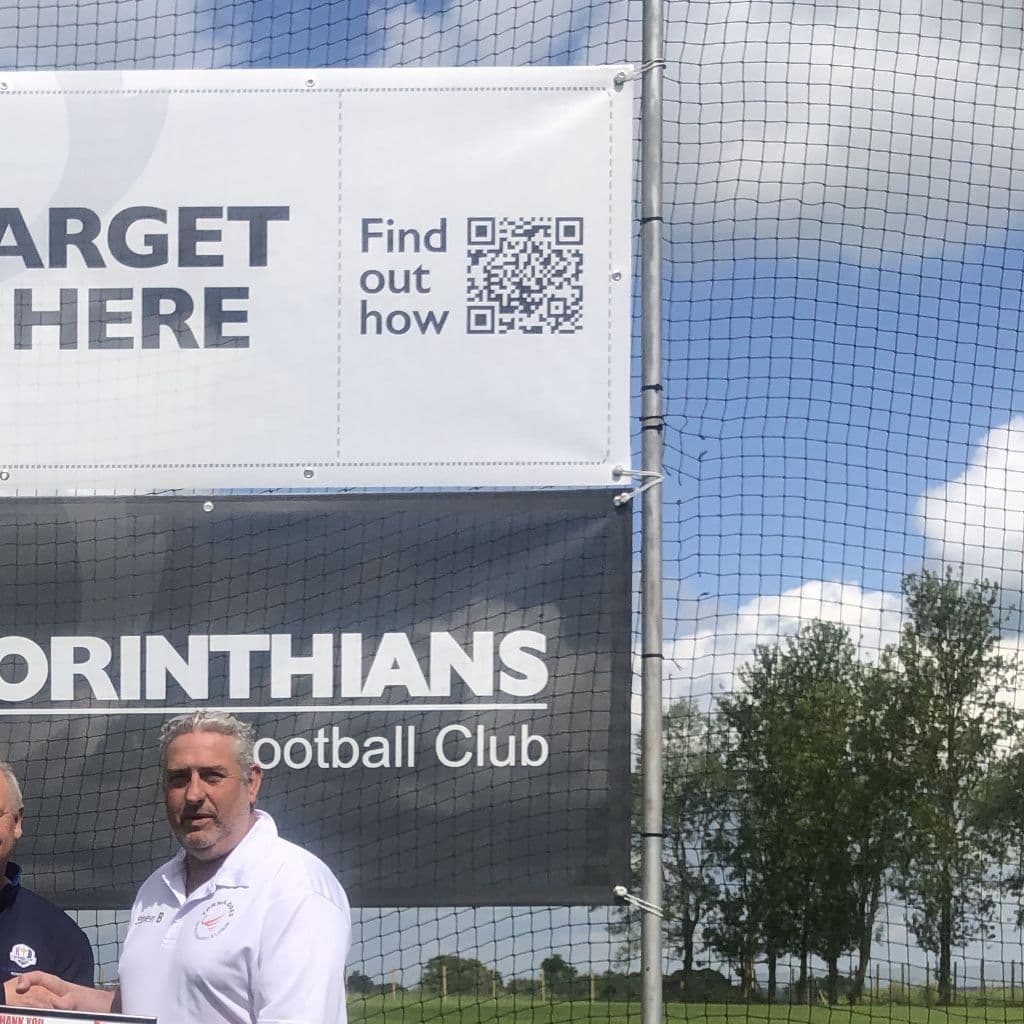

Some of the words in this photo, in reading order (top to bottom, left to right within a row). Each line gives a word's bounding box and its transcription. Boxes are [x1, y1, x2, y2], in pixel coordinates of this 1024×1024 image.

[362, 218, 446, 253] Find
[360, 265, 430, 294] out
[14, 287, 249, 350] HERE
[361, 300, 449, 335] how
[253, 726, 415, 769] ootball
[435, 724, 549, 768] Club
